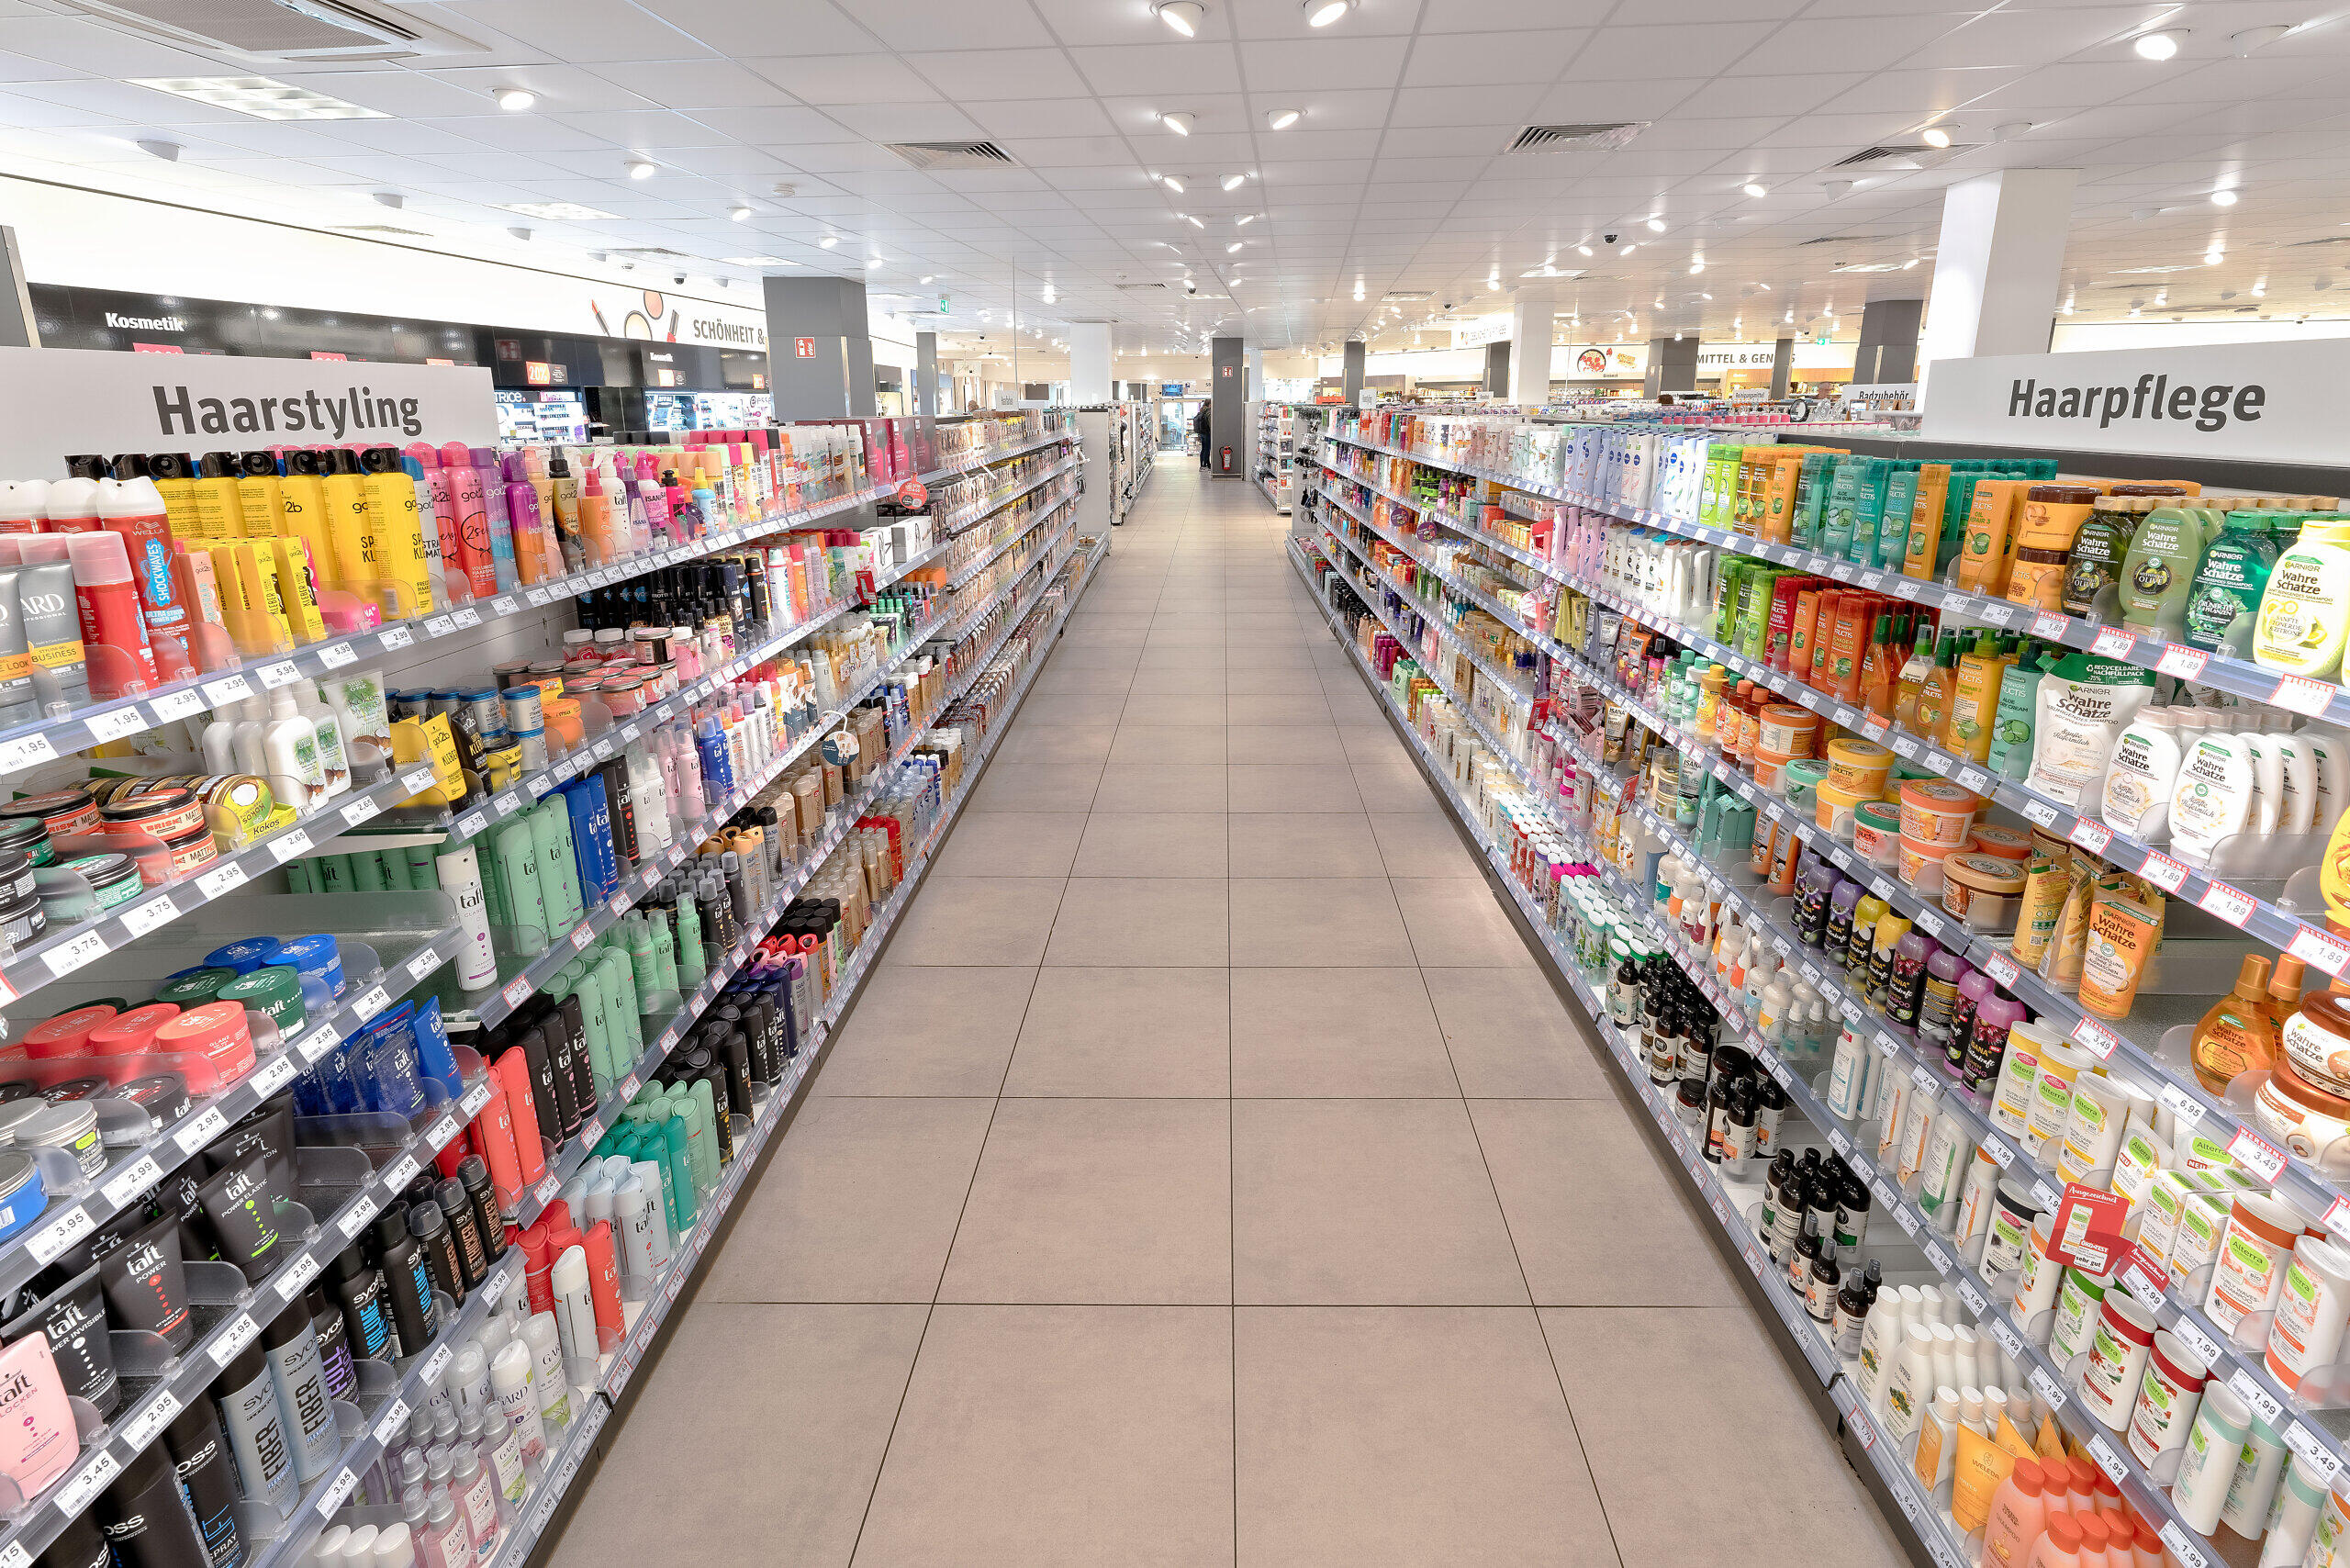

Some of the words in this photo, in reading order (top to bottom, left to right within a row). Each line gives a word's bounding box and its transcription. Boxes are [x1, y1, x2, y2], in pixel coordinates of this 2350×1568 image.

[106, 312, 184, 332] Kosmetik
[693, 319, 754, 342] SCHÖNHEIT
[757, 330, 765, 345] &
[1697, 354, 1735, 364] MITTEL
[1739, 354, 1747, 364] &
[1859, 391, 1909, 399] Badzubehör
[2009, 373, 2266, 431] Haarpflege
[152, 386, 422, 440] Haarstyling
[461, 488, 483, 502] got2
[560, 490, 577, 501] got2
[132, 527, 164, 536] WELLA
[2083, 529, 2109, 538] GARNIER
[2149, 523, 2178, 532] GARNIER
[2081, 536, 2108, 549] Wahre
[2147, 532, 2177, 543] Wahre
[2210, 550, 2243, 561] GARNIER
[151, 543, 169, 601] SHOCKWAVES
[2208, 558, 2242, 572] Wahre
[2285, 561, 2321, 573] GARNIER
[2139, 576, 2164, 586] OLIVE
[2281, 570, 2318, 585] Wahre
[20, 594, 65, 613] ARD
[2101, 626, 2136, 642] WERBUNG
[31, 648, 77, 663] BUSINESS
[2167, 644, 2209, 660] WERBUNG
[7, 660, 29, 670] LOOK
[2070, 684, 2110, 695] GARNIER
[2067, 689, 2111, 709] Wahre
[432, 732, 450, 748] got2b
[2053, 732, 2089, 746] Hafermilch
[2124, 738, 2149, 752] GARNIER
[2122, 745, 2147, 762] Wahre
[2199, 750, 2226, 762] GARNIER
[2197, 756, 2223, 773] Wahre
[49, 823, 74, 833] RISK
[2078, 817, 2113, 836] WERBUNG
[2149, 850, 2190, 873] WERBUNG
[459, 888, 485, 909] taft
[2211, 880, 2256, 907] WERBUNG
[2098, 914, 2134, 939] Wahre
[2103, 910, 2136, 929] GARNIER
[2083, 1016, 2118, 1043] WERBUNG
[2216, 1023, 2244, 1040] Wahre
[209, 1036, 230, 1047] GLANZ
[2291, 1029, 2322, 1052] Wahre
[2041, 1086, 2065, 1101] Alterra
[174, 1097, 192, 1118] taft
[2076, 1098, 2098, 1117] Alterra
[2132, 1142, 2151, 1160] Alterra
[2196, 1142, 2227, 1156] Alterra
[2240, 1126, 2288, 1163] WERBUNG
[2119, 1154, 2131, 1166] NEU
[225, 1173, 254, 1201] taft
[2069, 1187, 2119, 1204] Ausgezeichnet
[221, 1196, 244, 1218] POWER
[245, 1179, 268, 1199] ELASTIC
[2154, 1189, 2174, 1208] Alterra
[56, 1213, 84, 1236] 3,95
[1997, 1224, 2020, 1240] Alterra
[2187, 1214, 2209, 1234] Alterra
[462, 1220, 482, 1264] THICKER
[2081, 1240, 2109, 1253] ÖKO-TEST
[127, 1246, 164, 1275] taft
[2076, 1255, 2089, 1264] sehr
[2232, 1241, 2263, 1264] Alterra
[136, 1260, 167, 1283] POWER
[2131, 1248, 2165, 1283] Ausgezeichnet
[2250, 1273, 2262, 1282] BIO
[47, 1305, 87, 1341] taft
[360, 1299, 385, 1355] VOLUME
[0, 1387, 38, 1417] LOCKEN
[296, 1373, 327, 1435] FIBER
[1972, 1459, 1999, 1481] WELEDA
